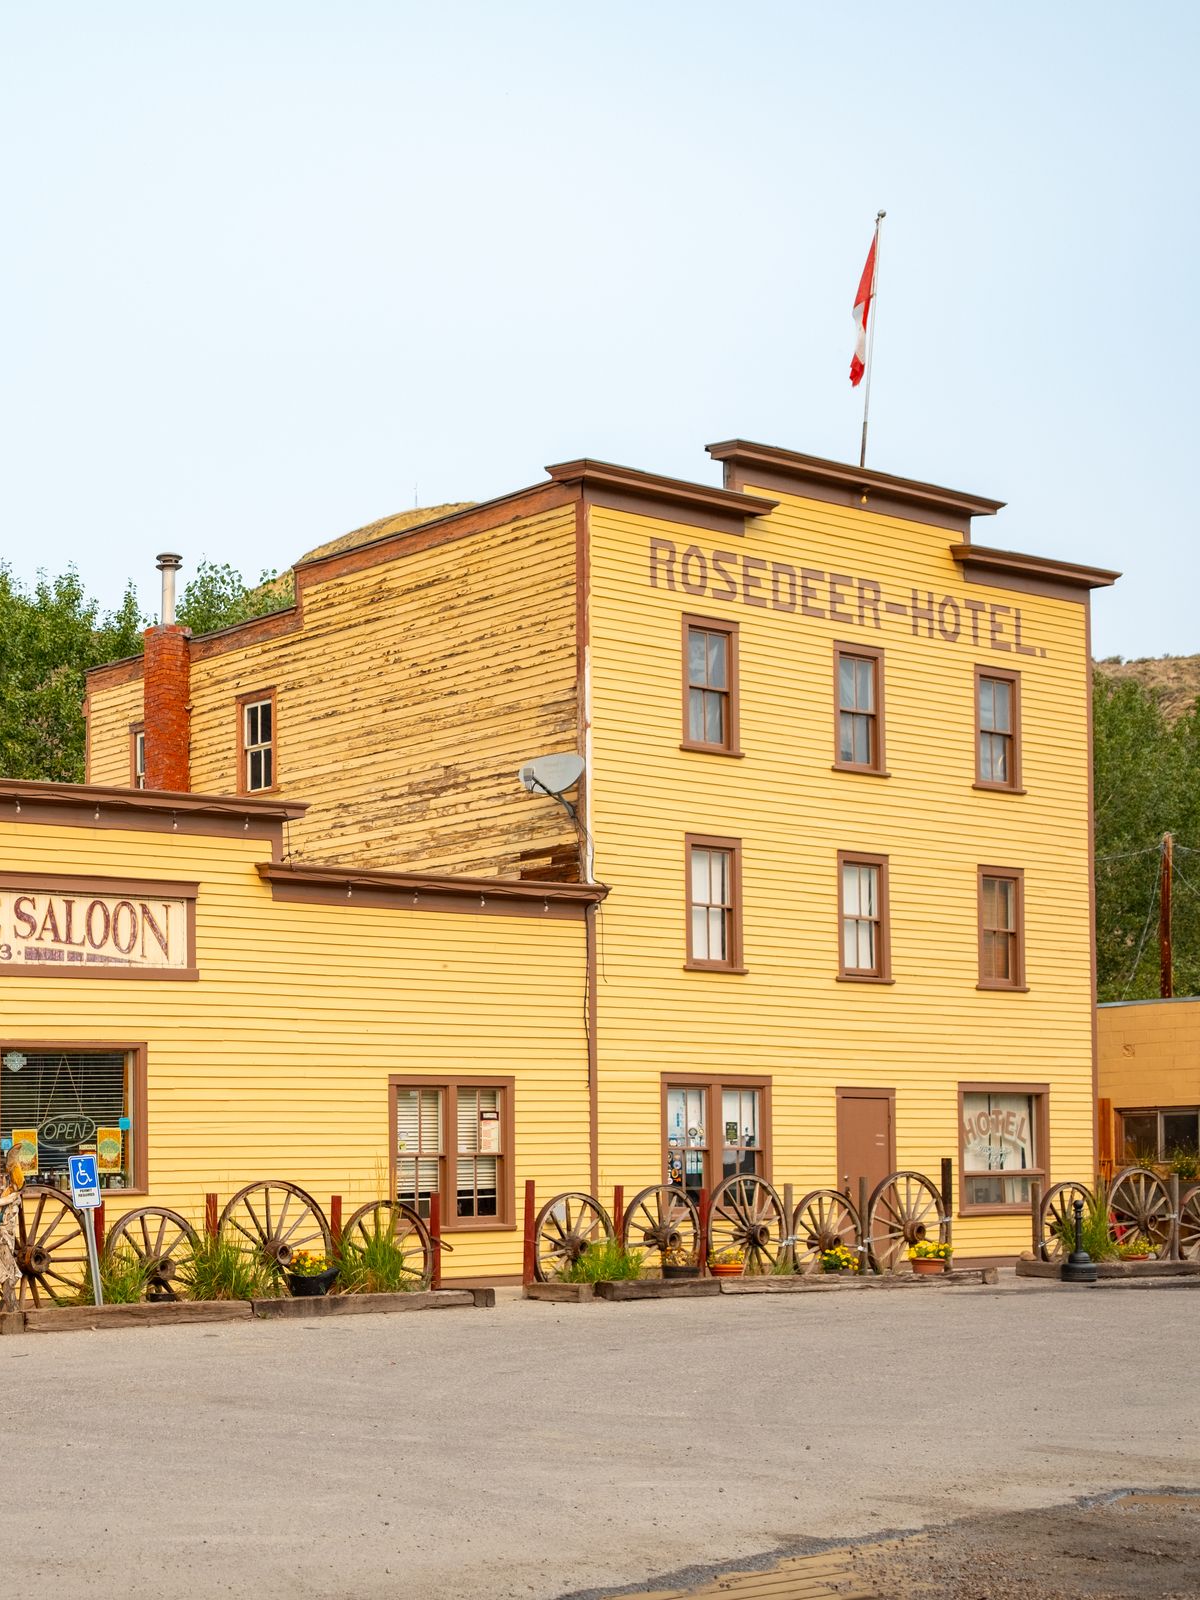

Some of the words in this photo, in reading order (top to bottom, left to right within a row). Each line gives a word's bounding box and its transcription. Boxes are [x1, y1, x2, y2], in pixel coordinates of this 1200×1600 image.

[13, 896, 172, 962] SALOON
[44, 1122, 87, 1140] OPEN
[963, 1109, 1028, 1147] HOTEL
